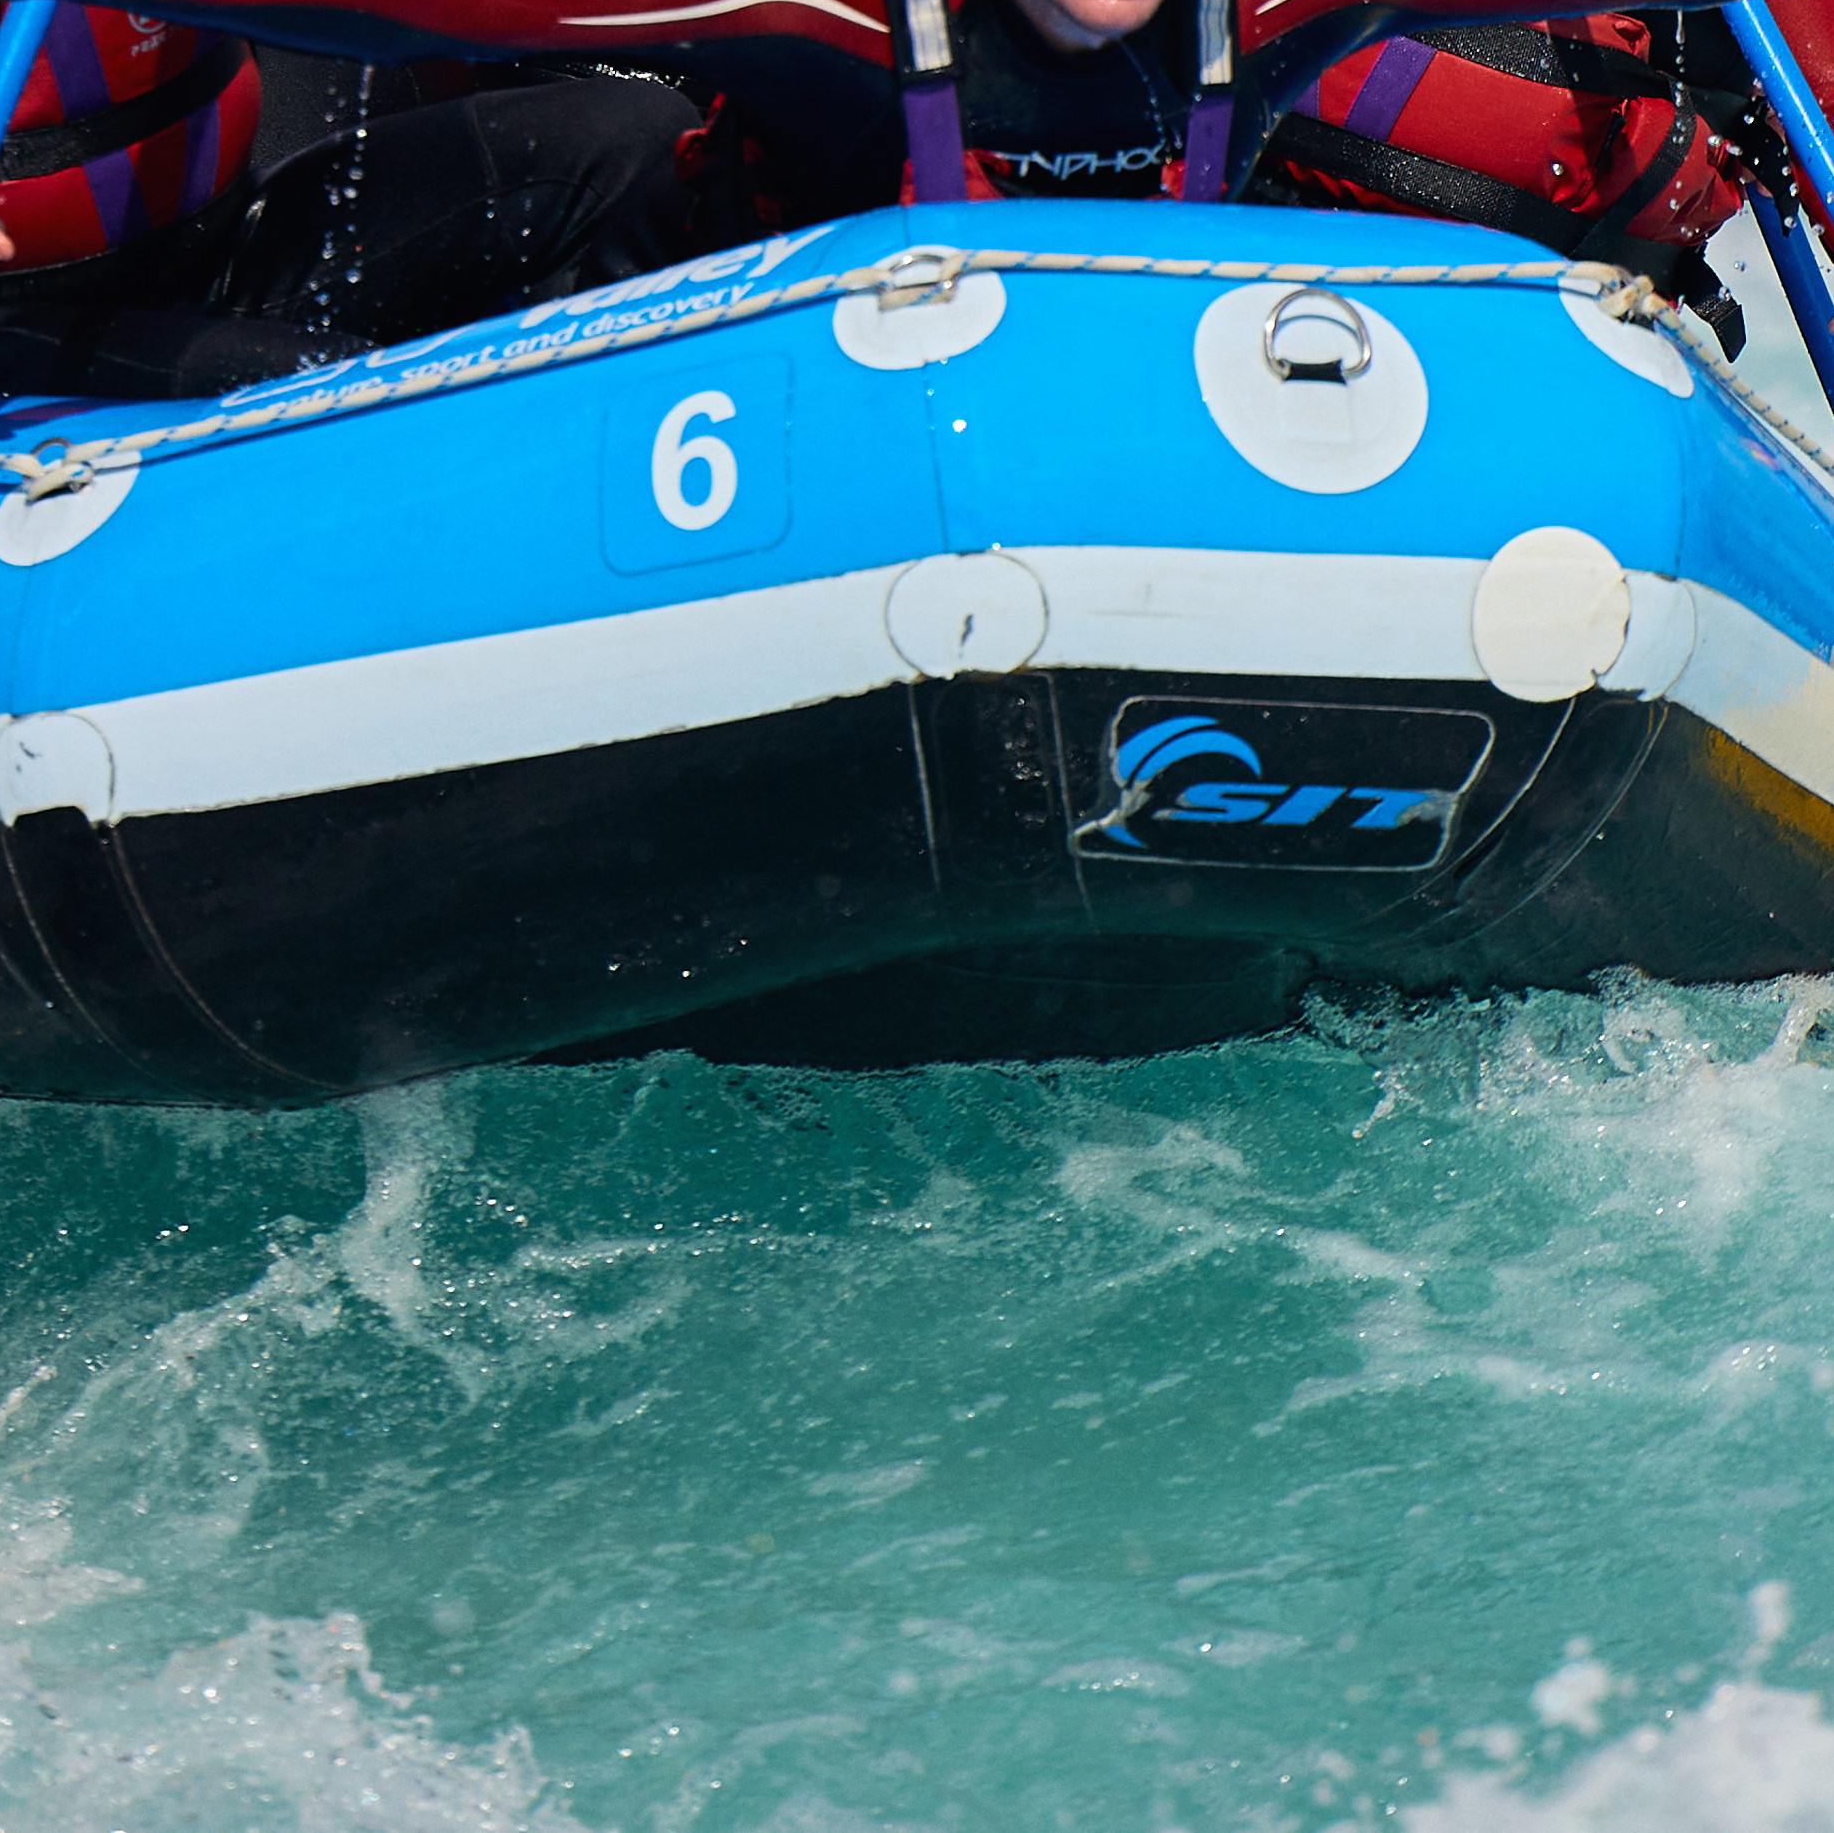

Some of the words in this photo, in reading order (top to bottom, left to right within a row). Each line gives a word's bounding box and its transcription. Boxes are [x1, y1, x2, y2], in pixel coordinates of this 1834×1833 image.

[503, 321, 578, 359] and
[582, 282, 756, 340] discovery
[651, 389, 739, 532] 6
